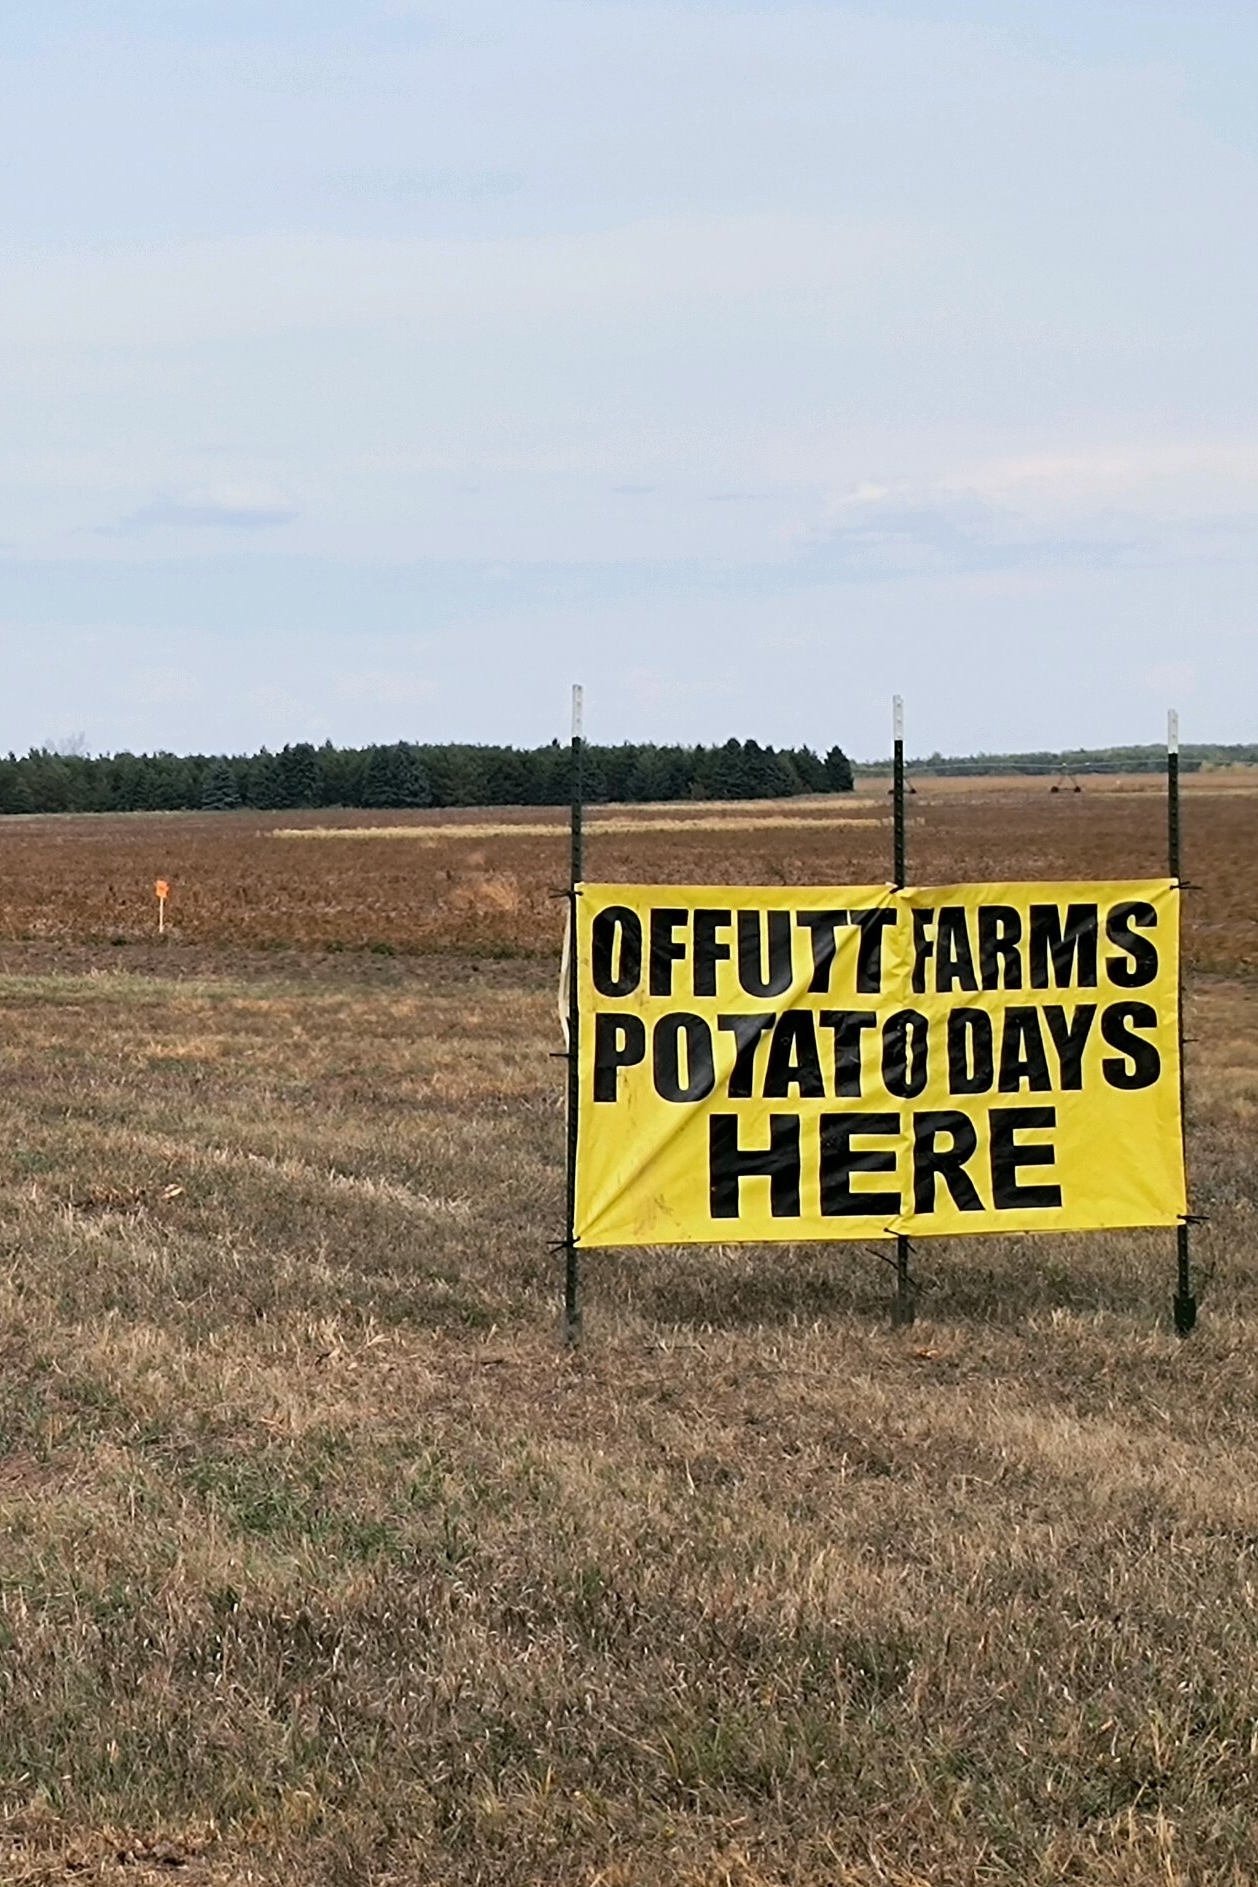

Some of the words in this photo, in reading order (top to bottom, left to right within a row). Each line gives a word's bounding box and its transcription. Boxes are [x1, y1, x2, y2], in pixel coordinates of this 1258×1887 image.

[591, 905, 897, 998] OFFUTT
[911, 901, 1159, 993] FARMS
[593, 1008, 929, 1102] POTATO
[947, 1001, 1162, 1095] DAYS
[709, 1106, 1064, 1219] HERE
